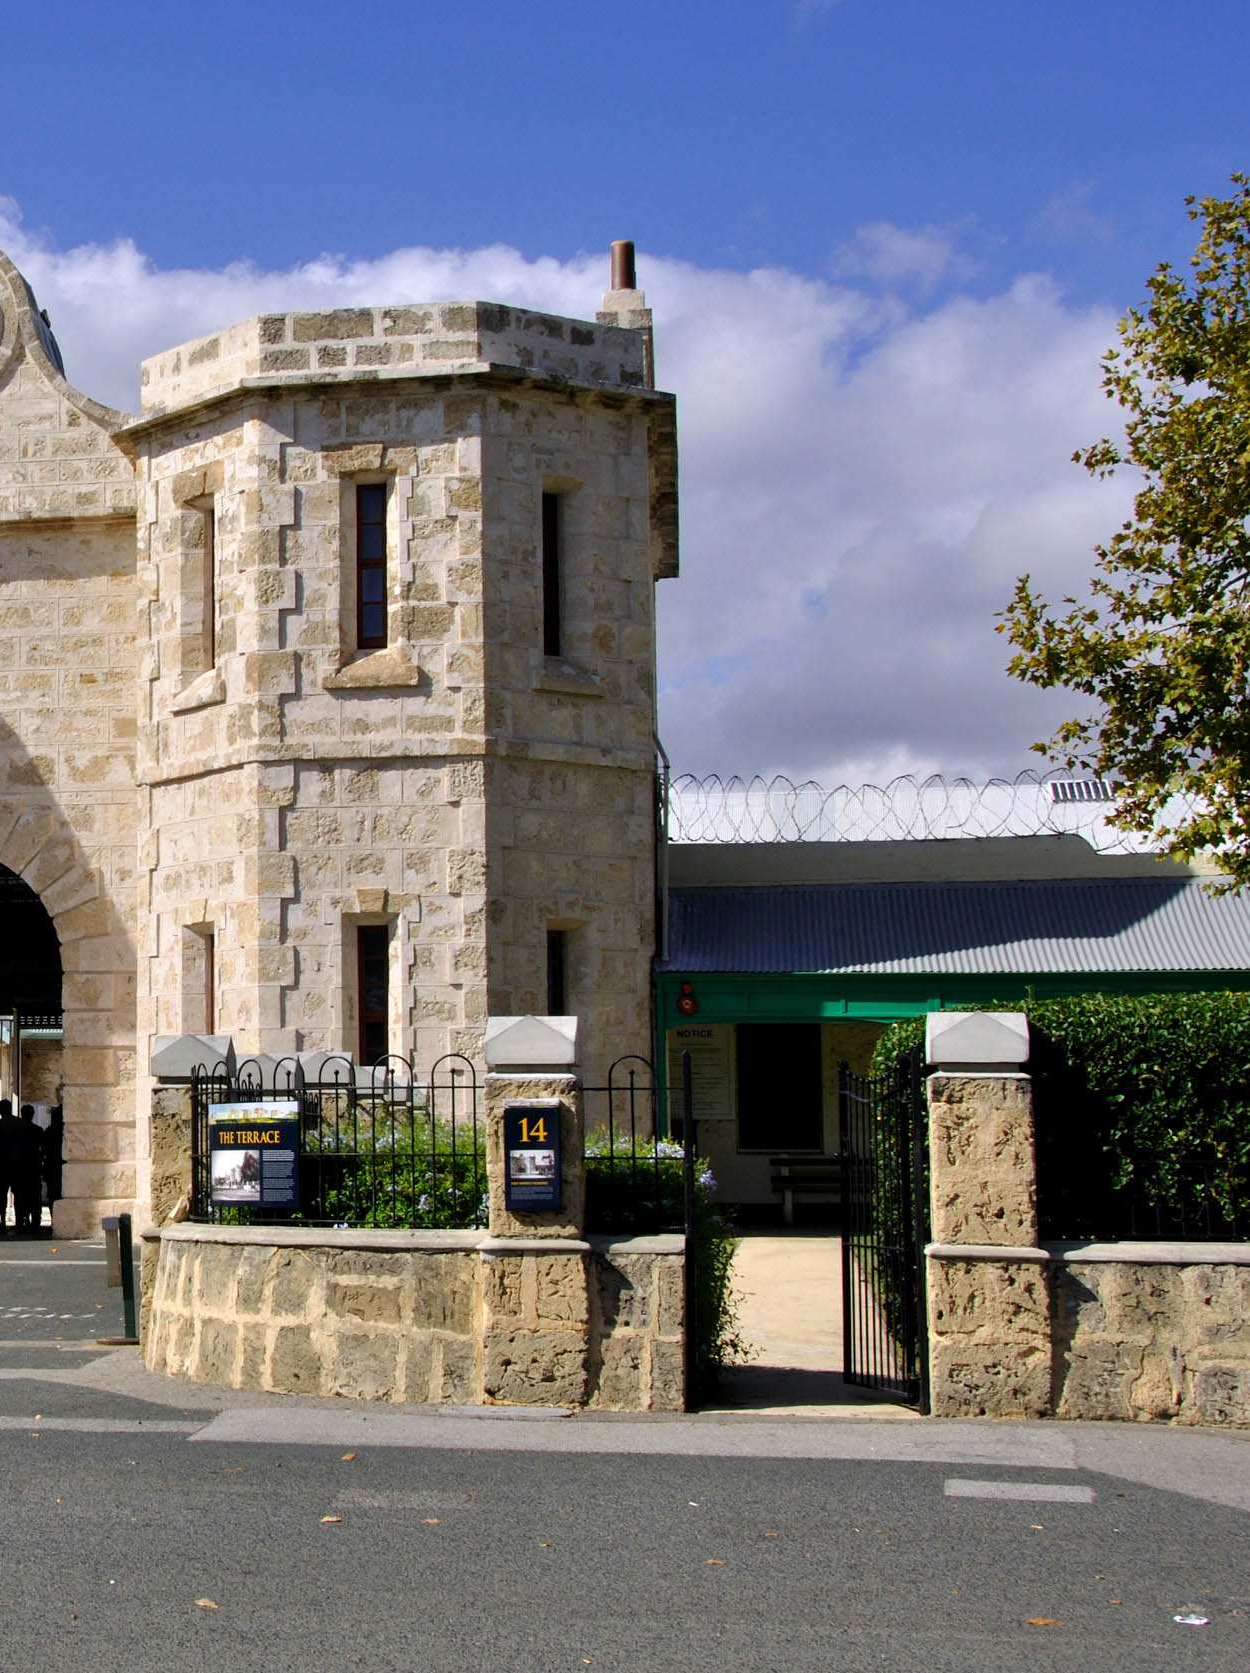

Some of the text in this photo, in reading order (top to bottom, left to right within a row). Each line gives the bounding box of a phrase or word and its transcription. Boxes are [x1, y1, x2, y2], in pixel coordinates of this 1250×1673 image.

[676, 1029, 714, 1039] NOTICE
[518, 1117, 549, 1142] 14
[218, 1130, 281, 1144] THE TERRACE
